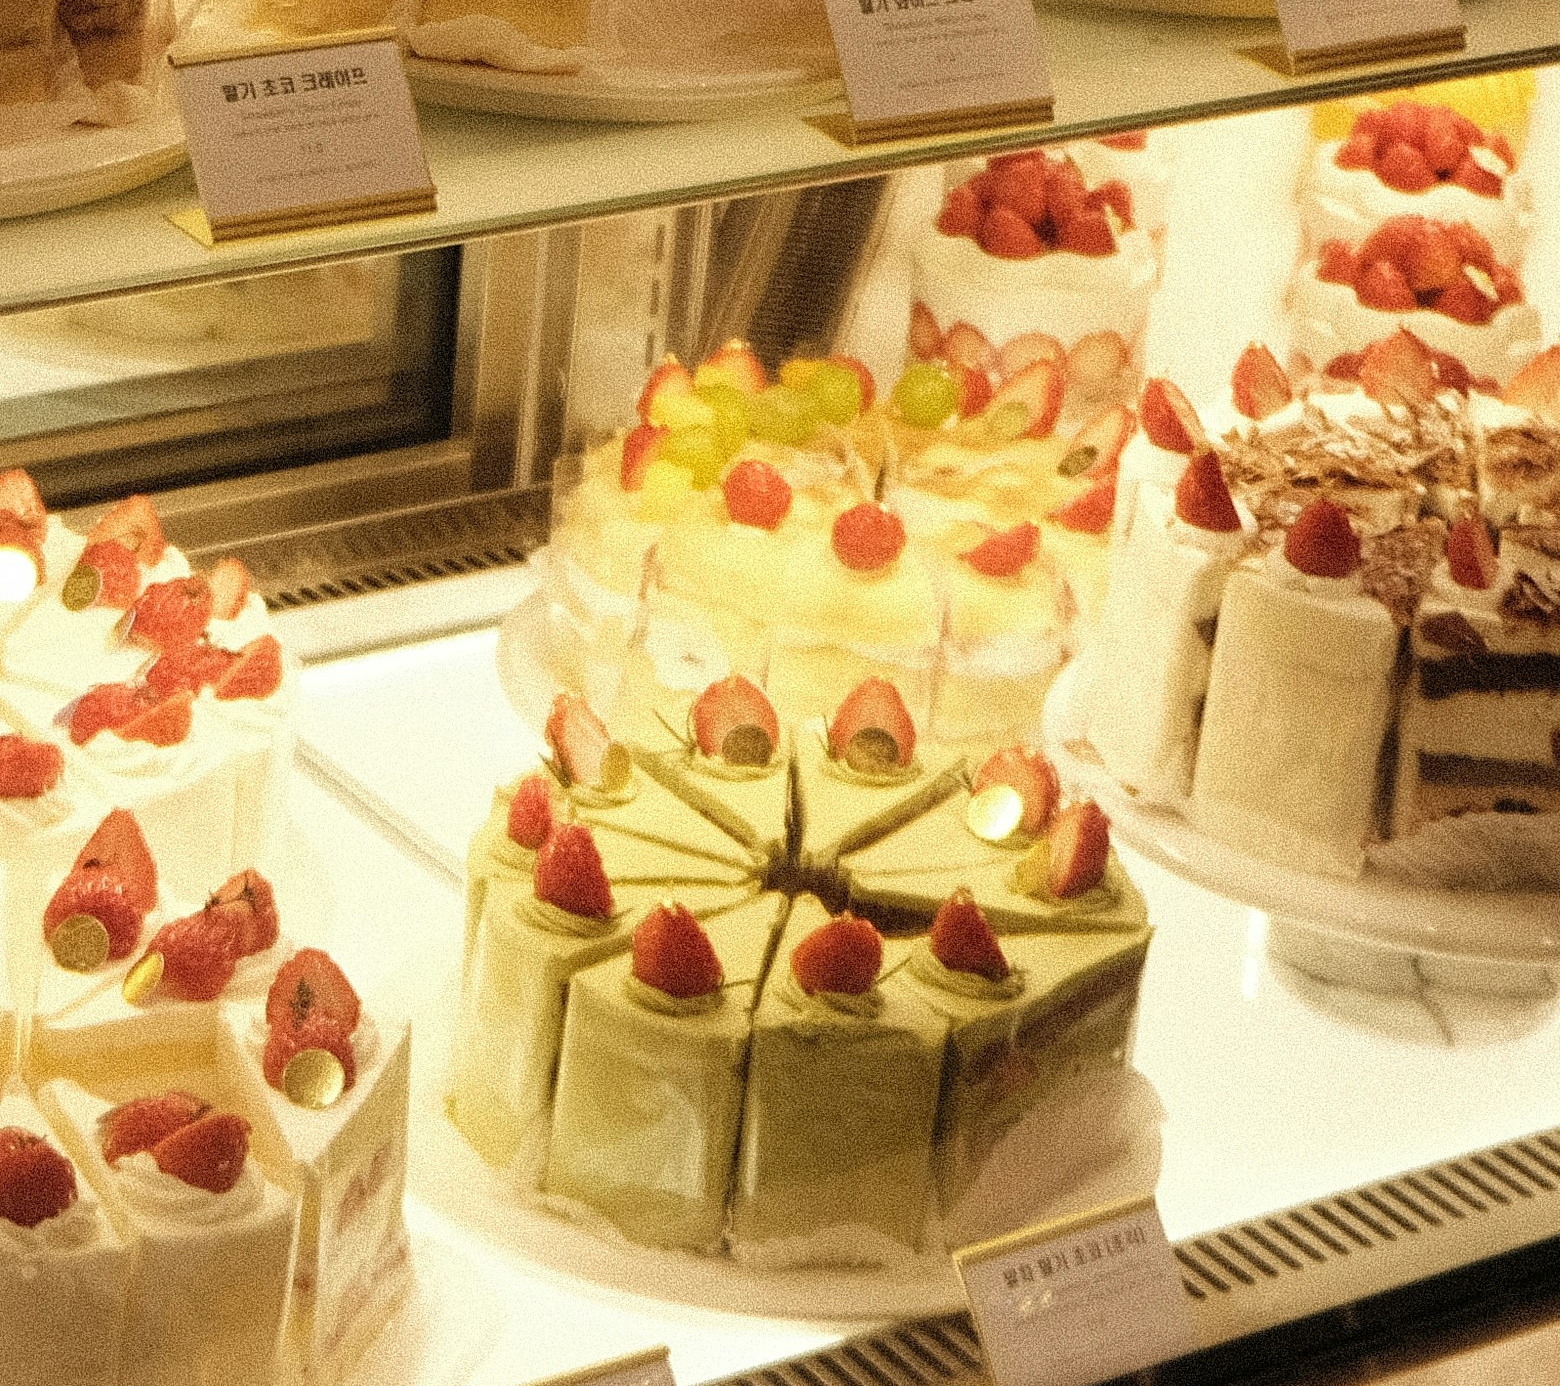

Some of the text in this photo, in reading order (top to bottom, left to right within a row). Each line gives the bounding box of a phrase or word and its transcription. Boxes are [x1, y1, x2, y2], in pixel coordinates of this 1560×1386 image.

[221, 66, 369, 103] 딸기 초코 크레이프
